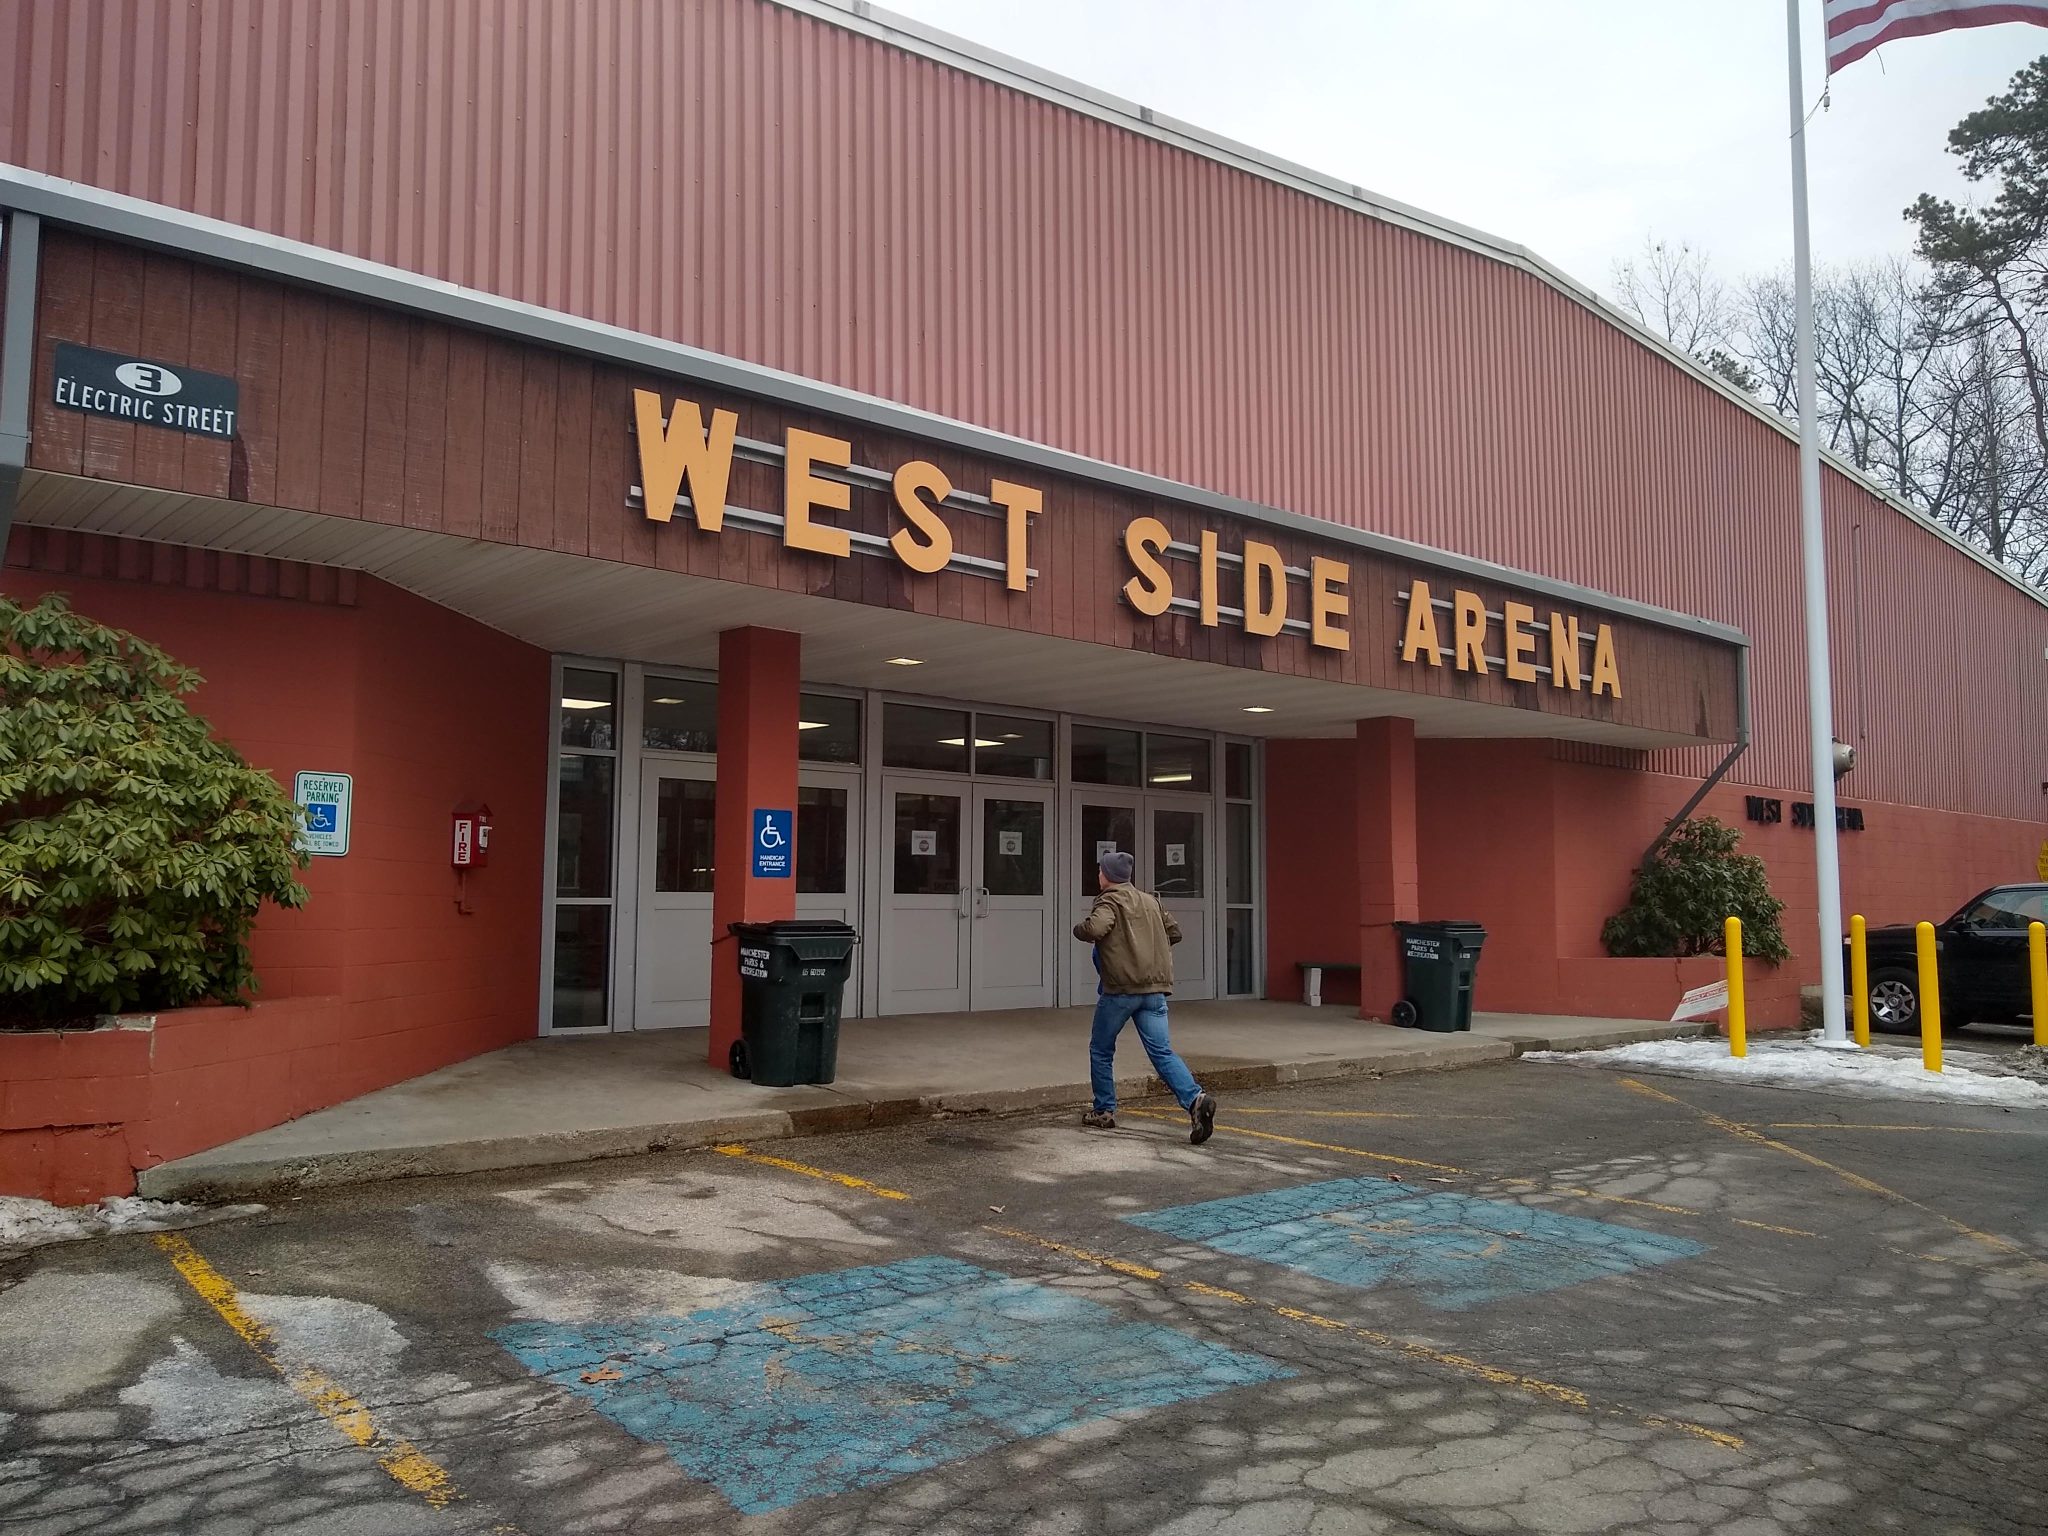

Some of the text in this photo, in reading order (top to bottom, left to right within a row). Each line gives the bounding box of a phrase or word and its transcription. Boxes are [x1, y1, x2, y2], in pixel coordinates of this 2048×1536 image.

[135, 365, 162, 393] 3
[56, 377, 235, 435] ELECTRIC STREET
[633, 388, 1623, 698] WEST SIDE ARENA
[303, 779, 344, 793] RESERVED
[306, 791, 340, 803] PARKING
[458, 822, 468, 862] FIRE
[1406, 938, 1440, 947] MANCHESTER
[1411, 945, 1427, 953] PARKS
[740, 946, 770, 960] MANCHESTER
[1407, 950, 1439, 960] RECREATION
[744, 957, 759, 967] PARKS
[741, 965, 768, 978] RECREATION
